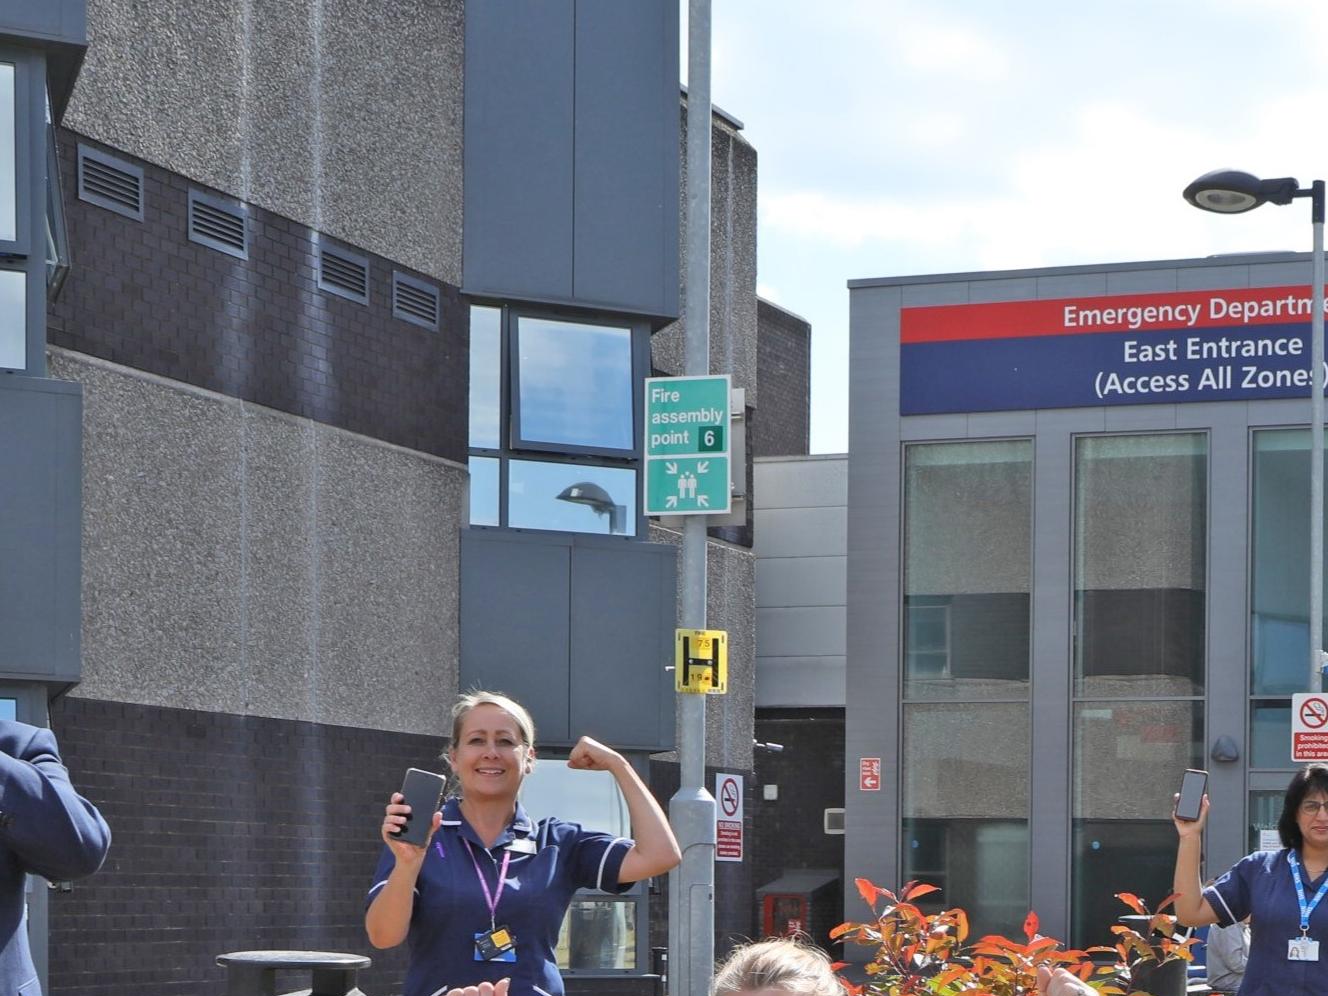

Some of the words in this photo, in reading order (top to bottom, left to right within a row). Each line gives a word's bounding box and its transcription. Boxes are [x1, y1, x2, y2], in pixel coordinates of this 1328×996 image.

[1063, 300, 1202, 330] Emergency
[1123, 340, 1178, 363] East
[1187, 336, 1304, 360] Entrance
[1094, 371, 1190, 400] (Access
[1197, 365, 1232, 390] All
[651, 387, 681, 403] Fire
[651, 407, 724, 425] assembly
[651, 430, 690, 449] point
[704, 430, 715, 447] 6
[1299, 734, 1328, 743] Smoking
